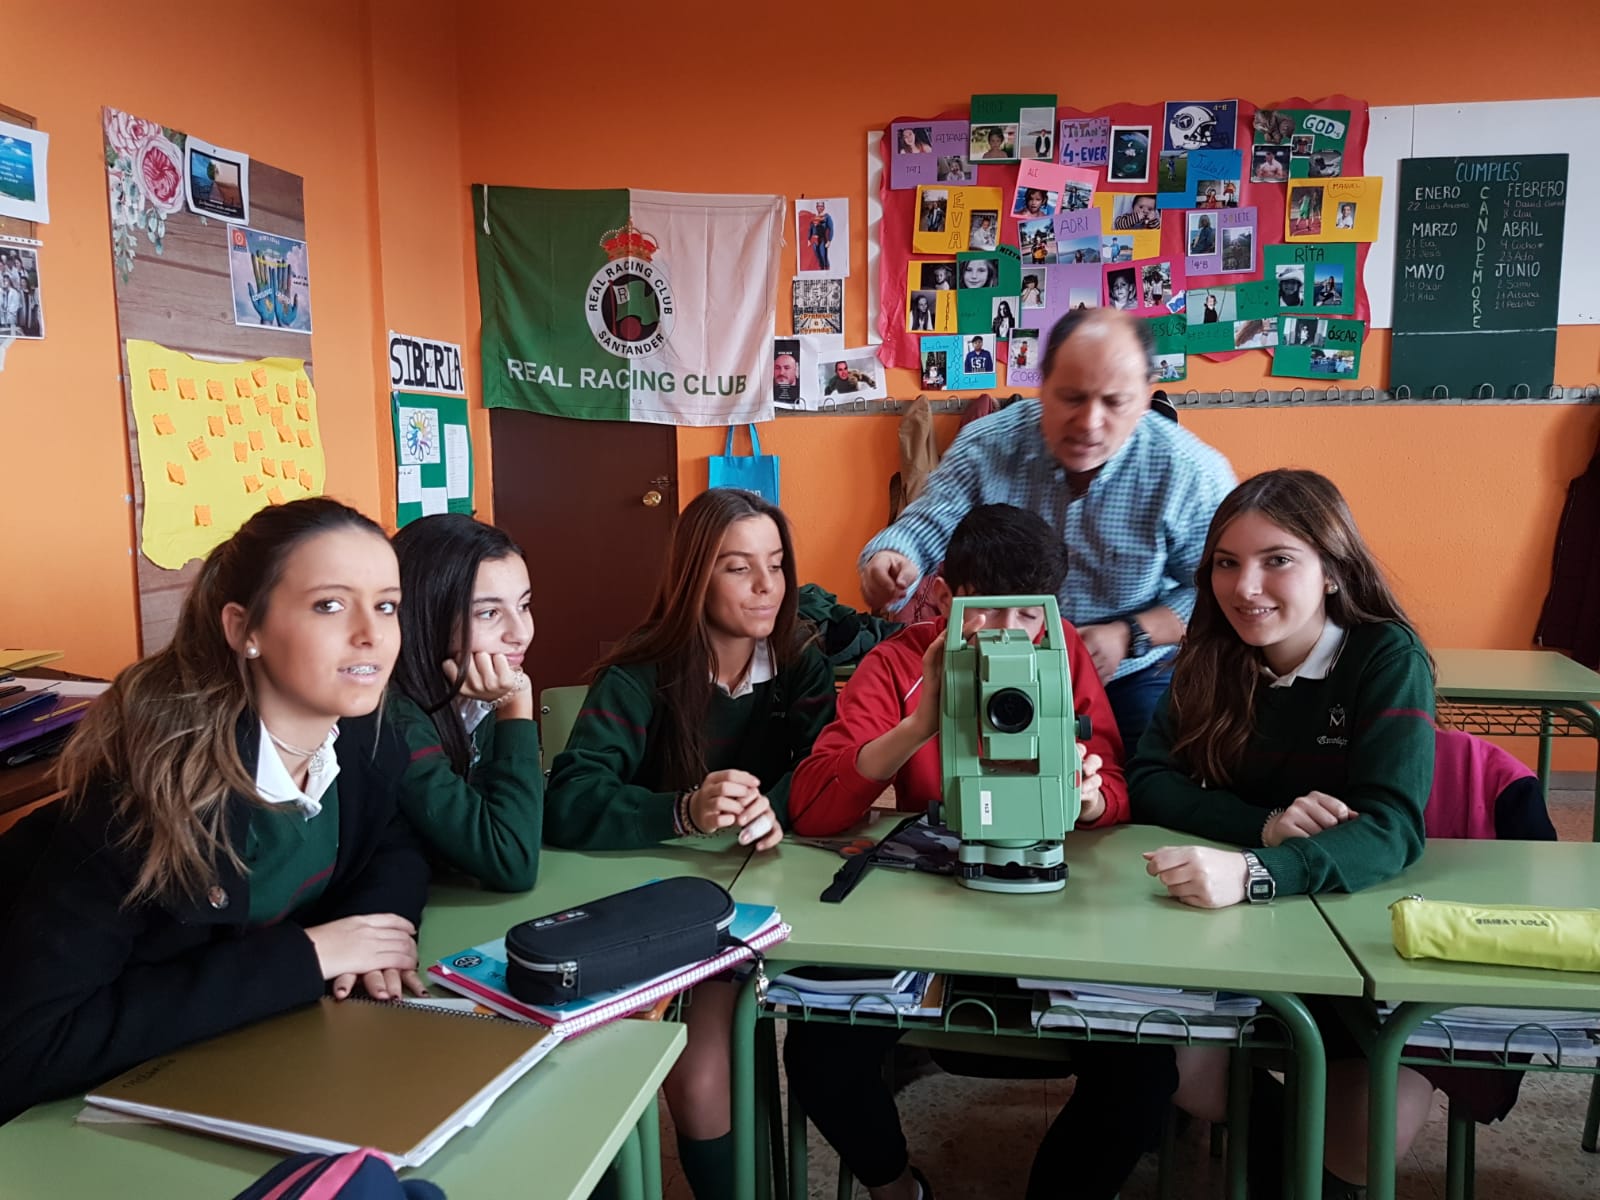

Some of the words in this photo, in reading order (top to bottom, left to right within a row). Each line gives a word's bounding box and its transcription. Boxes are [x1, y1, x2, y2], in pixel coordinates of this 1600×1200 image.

[1062, 143, 1107, 162] 4-EVER
[1455, 161, 1522, 183] CUMPLES
[1415, 186, 1461, 201] ENERO
[1507, 180, 1565, 198] FEBRERO
[1407, 201, 1421, 211] 22
[948, 191, 965, 249] EVA
[1059, 216, 1089, 235] ADRI
[1502, 221, 1544, 237] ABRIL
[1411, 222, 1458, 238] MARZO
[1294, 245, 1325, 264] RITA
[1404, 264, 1445, 281] MAYO
[1494, 261, 1541, 277] JUNIO
[588, 279, 606, 312] REAL
[605, 260, 653, 278] RACING
[654, 279, 673, 315] CLUB
[598, 330, 665, 355] SANTANDER
[1327, 325, 1357, 344] ÓSCAR
[390, 337, 464, 391] SIBERIA
[507, 358, 572, 388] REAL
[580, 368, 676, 393] RACING
[683, 374, 747, 397] CLUB
